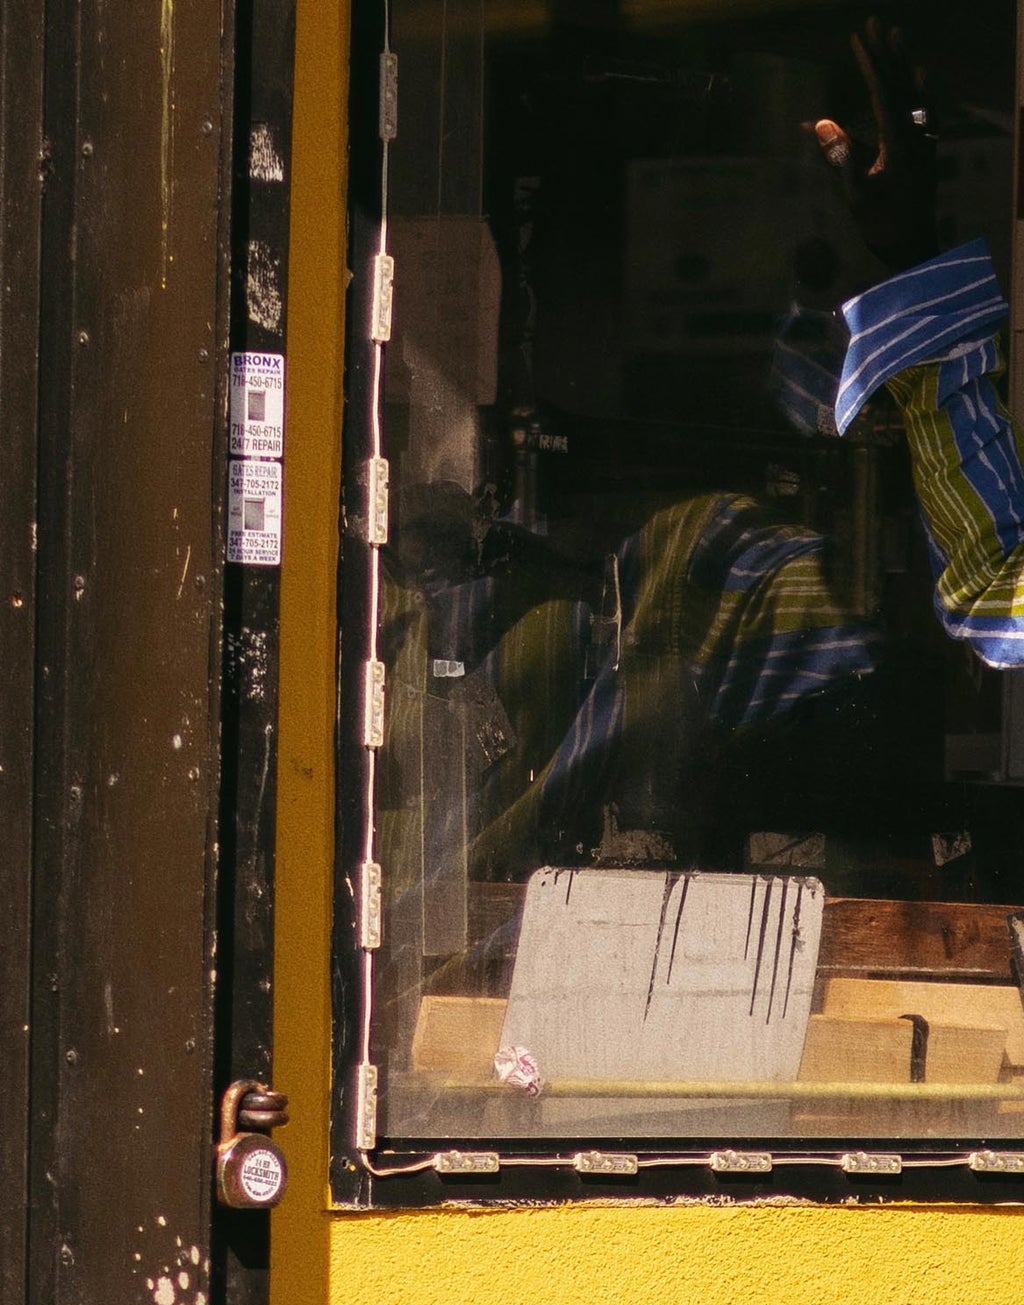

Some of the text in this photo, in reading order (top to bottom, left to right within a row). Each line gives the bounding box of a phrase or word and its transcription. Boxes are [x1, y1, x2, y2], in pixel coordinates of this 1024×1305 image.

[233, 355, 281, 369] BRONX
[232, 374, 282, 389] 718-450-6715
[231, 423, 282, 438] 718-450-6715
[231, 437, 281, 452] 24/7 REPAIR
[232, 464, 278, 478] GATES REPAIR
[230, 478, 279, 490] 347-705-2172
[233, 489, 277, 497] INSTALLATION
[229, 537, 279, 549] 347-705-2172
[255, 548, 279, 556] SERVICE
[244, 1165, 279, 1180] LOCKSMITH
